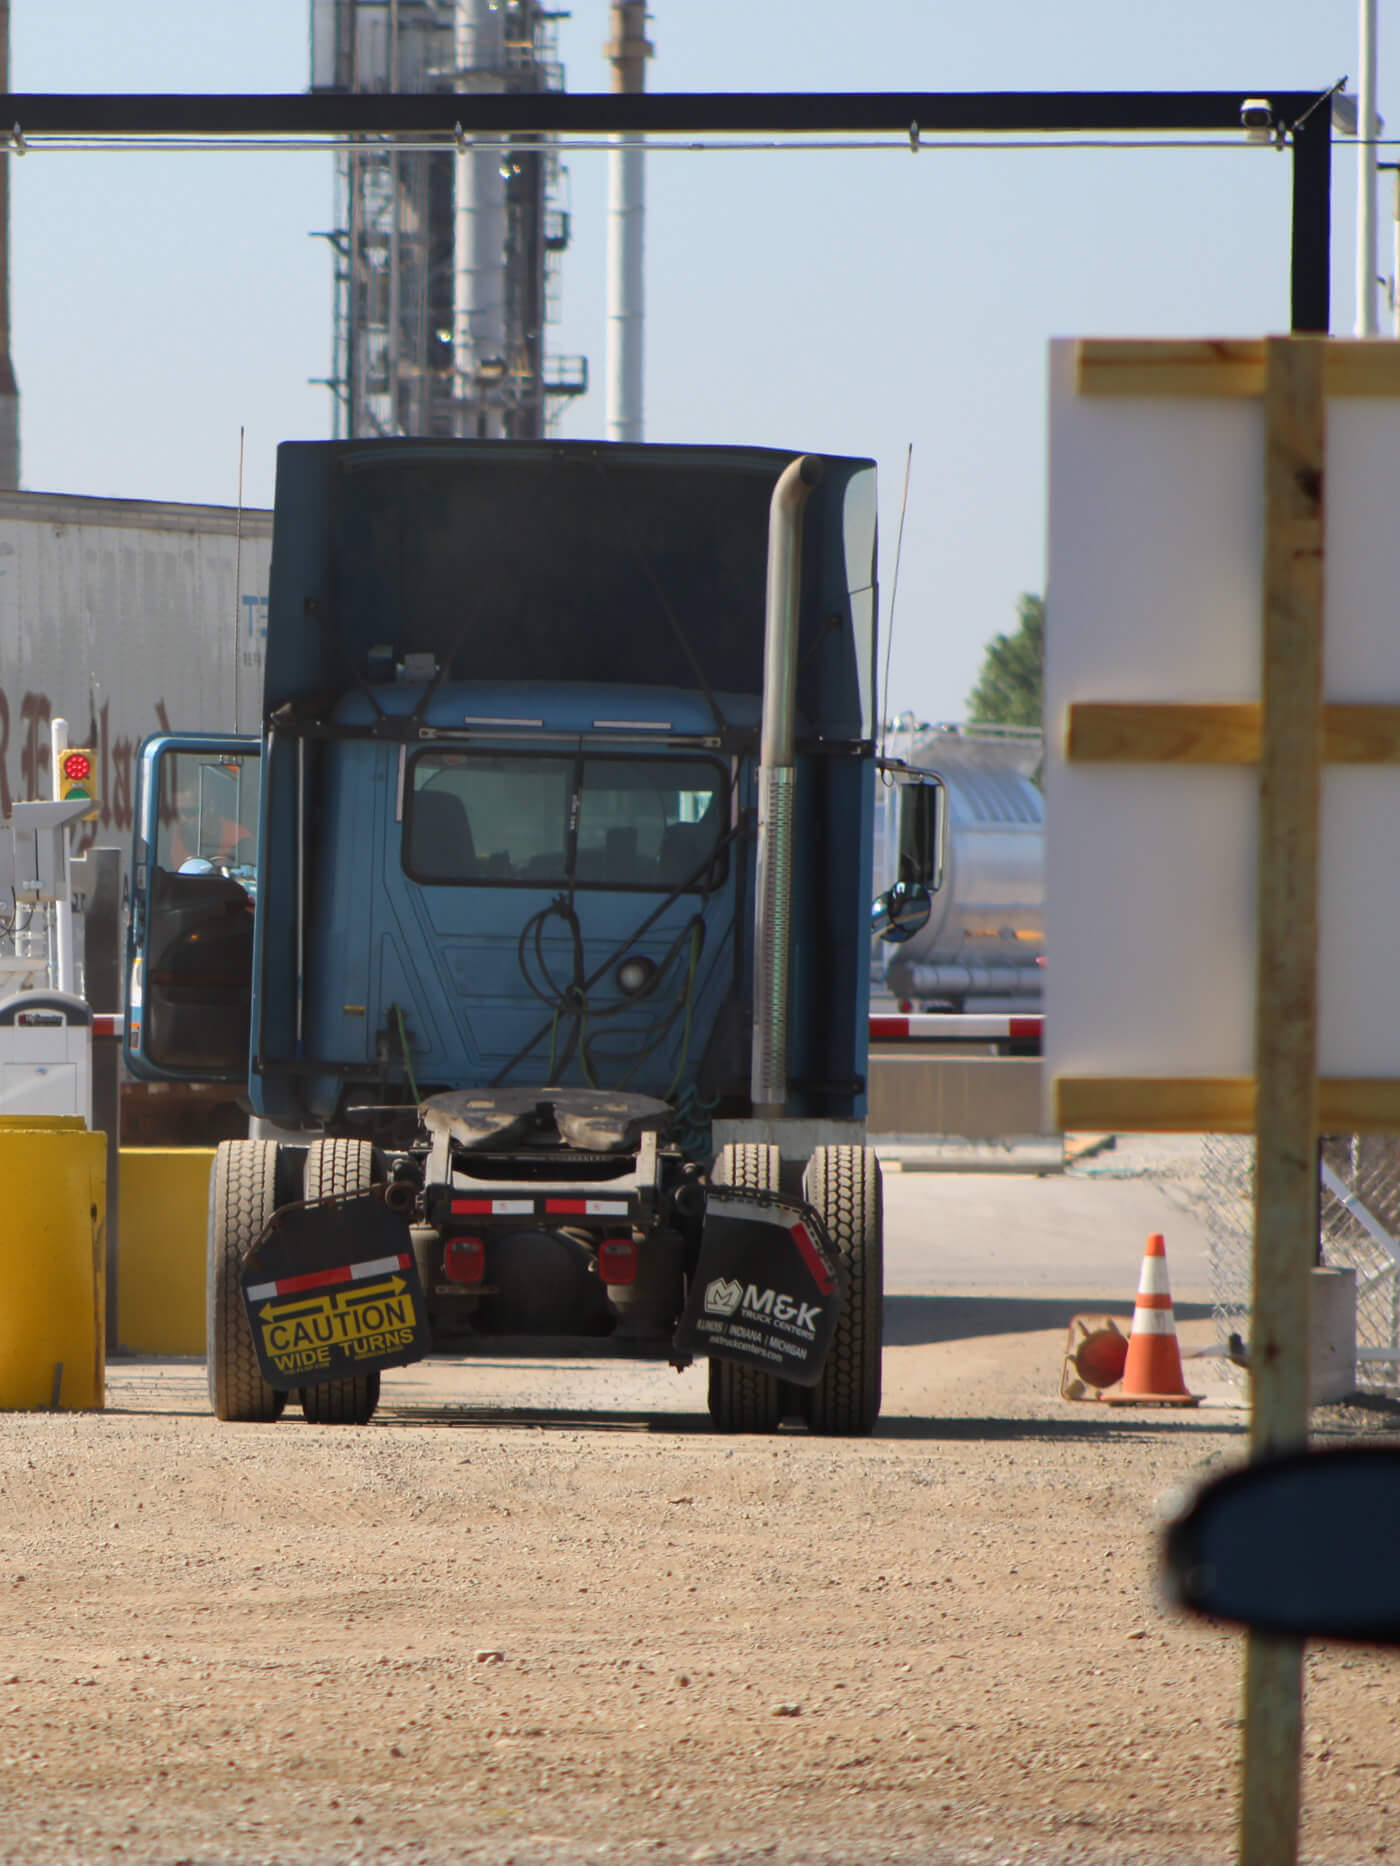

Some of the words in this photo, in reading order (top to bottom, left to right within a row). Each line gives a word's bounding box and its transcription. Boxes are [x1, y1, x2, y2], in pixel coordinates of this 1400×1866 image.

[269, 1300, 408, 1351] CAUTION
[741, 1308, 772, 1325] TRUCK
[773, 1319, 816, 1342] CENTERS
[742, 1284, 823, 1332] M&K
[273, 1346, 332, 1371] WIDE
[338, 1328, 415, 1356] TURNS
[728, 1324, 762, 1343] INDIANA
[769, 1335, 808, 1361] MICHIGAN
